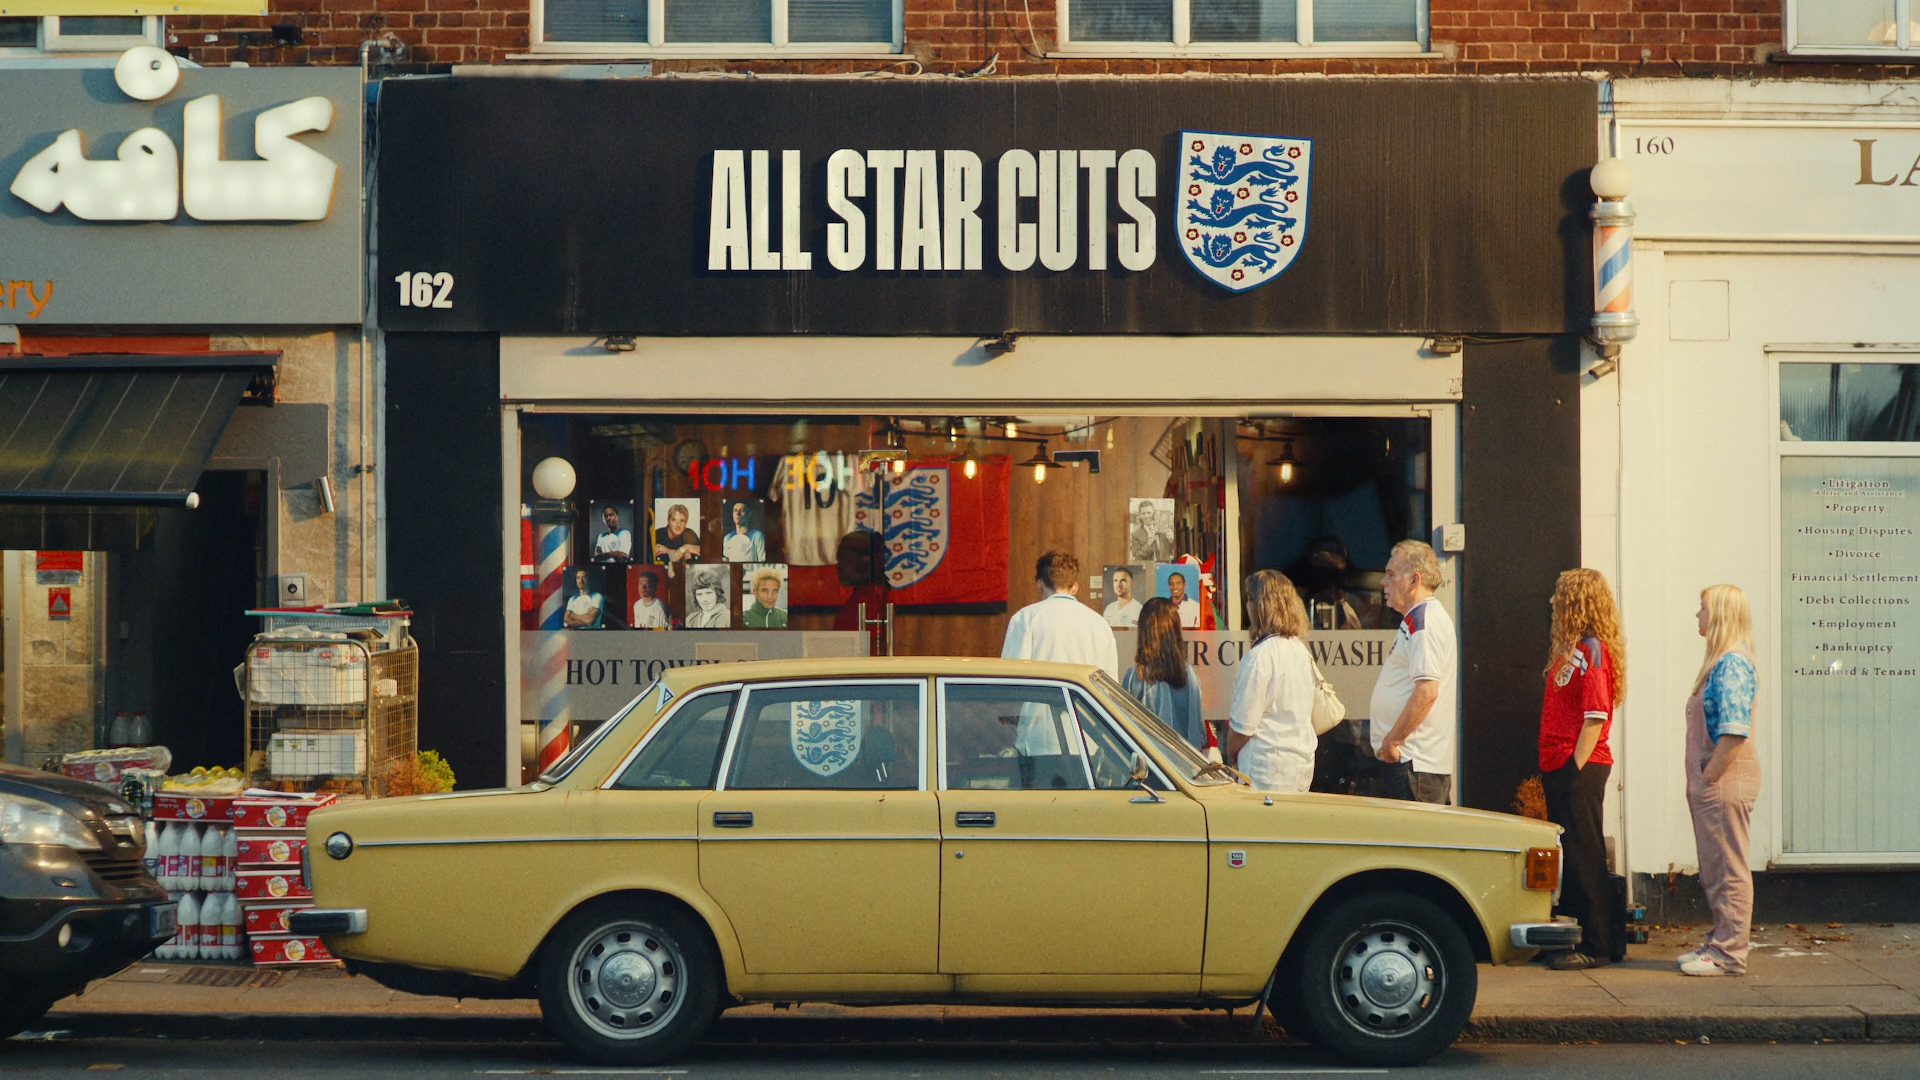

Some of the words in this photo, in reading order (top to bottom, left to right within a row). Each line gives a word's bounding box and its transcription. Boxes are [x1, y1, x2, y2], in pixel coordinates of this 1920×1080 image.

[1635, 137, 1674, 155] 160
[708, 149, 812, 271] ALL
[827, 148, 983, 272] STAR
[998, 148, 1157, 272] CUTS
[395, 271, 454, 309] 162
[0, 279, 53, 319] ry
[1829, 480, 1889, 489] Litigation
[1833, 504, 1885, 514] Property
[1805, 526, 1855, 537] Housing
[1859, 527, 1913, 537] Disputes
[1792, 573, 1847, 581] Financial
[1806, 596, 1834, 604] Debt
[1840, 596, 1910, 604] Collections
[1819, 619, 1896, 630] Employment
[1308, 640, 1384, 666] WASH
[1822, 643, 1893, 653] Bankruptcy
[566, 659, 623, 685] HOT
[1801, 667, 1856, 676] Landlord
[1862, 668, 1869, 676] &
[1874, 668, 1916, 676] Tenant
